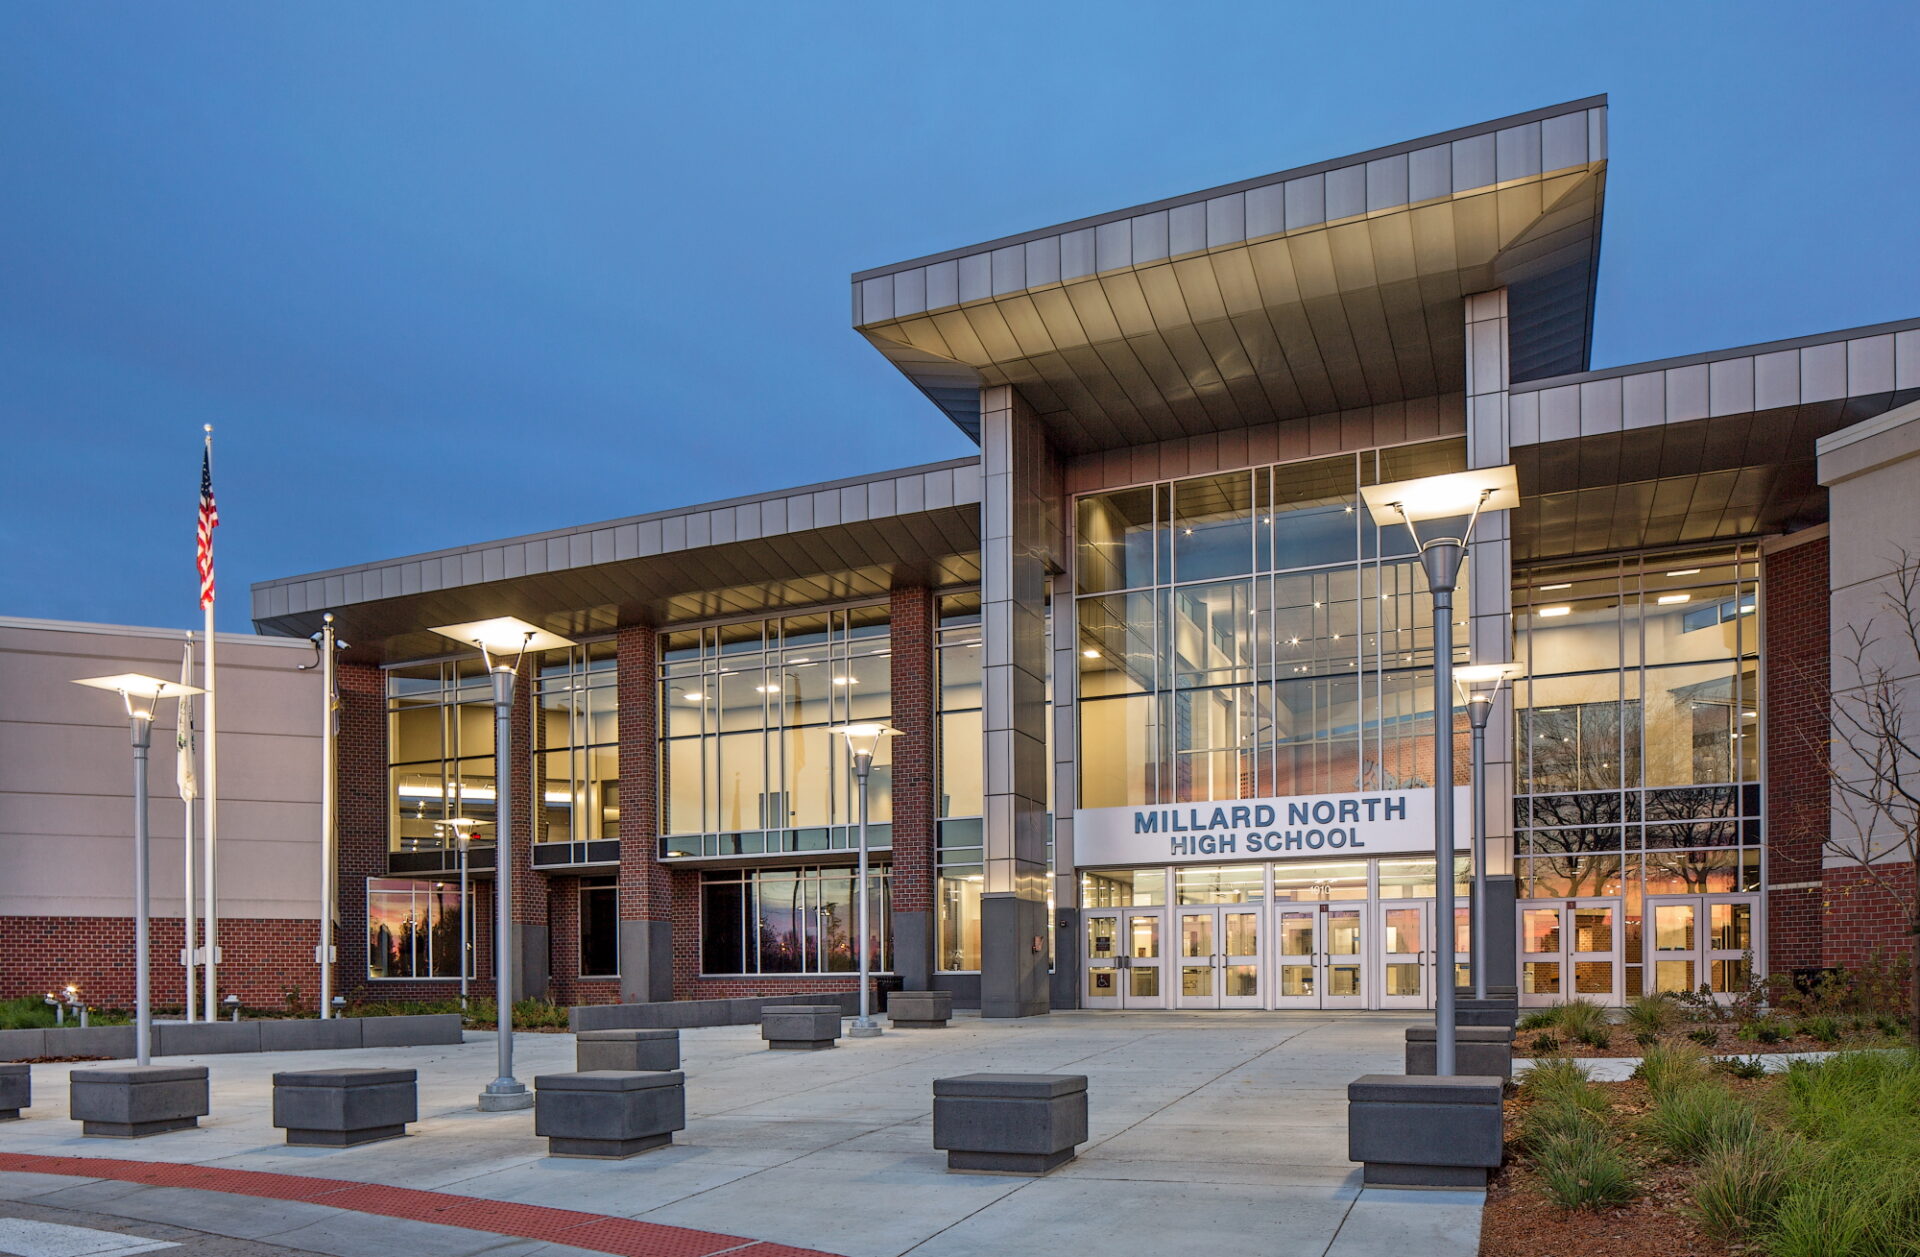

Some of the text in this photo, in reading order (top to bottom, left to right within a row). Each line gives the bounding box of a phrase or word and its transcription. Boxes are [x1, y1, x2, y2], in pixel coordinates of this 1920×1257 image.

[1134, 796, 1406, 834] MILLARD NORTH
[1170, 827, 1365, 856] HIGH SCHOOL
[1309, 885, 1331, 895] 1010
